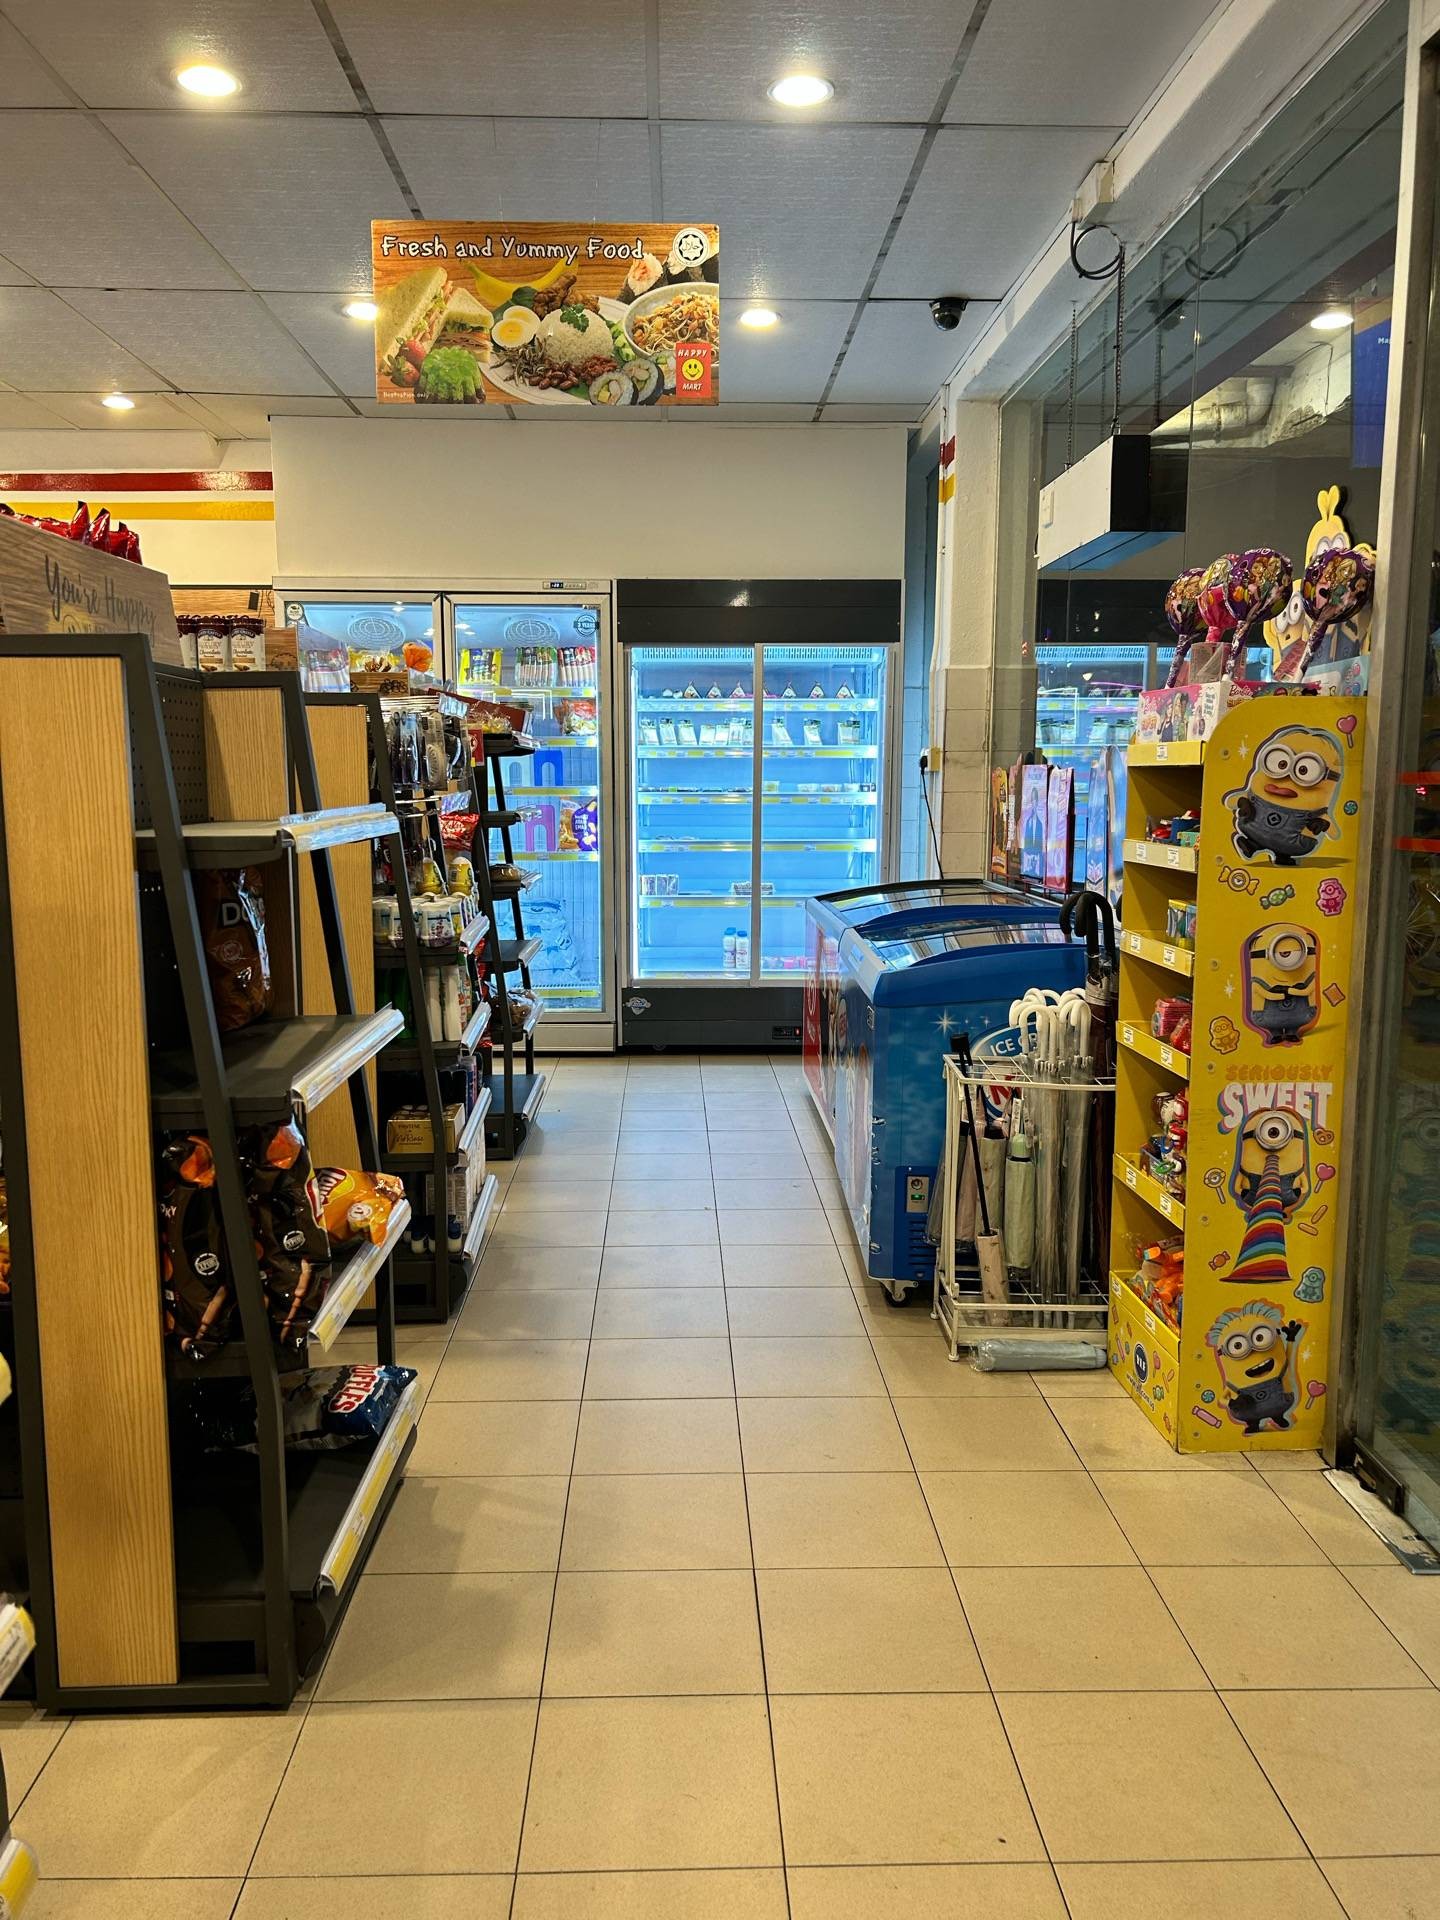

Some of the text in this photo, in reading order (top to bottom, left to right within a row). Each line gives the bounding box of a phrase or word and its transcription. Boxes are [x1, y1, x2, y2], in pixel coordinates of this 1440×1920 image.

[381, 234, 644, 266] Fresh and Yummy Food
[677, 349, 707, 357] HAPPY
[682, 383, 702, 391] MART
[45, 553, 156, 649] You're Happy
[990, 1038, 1016, 1056] ICE
[1225, 1064, 1334, 1080] SERIOUSLY
[1221, 1081, 1333, 1130] SWEET
[329, 1365, 382, 1413] UFFLES
